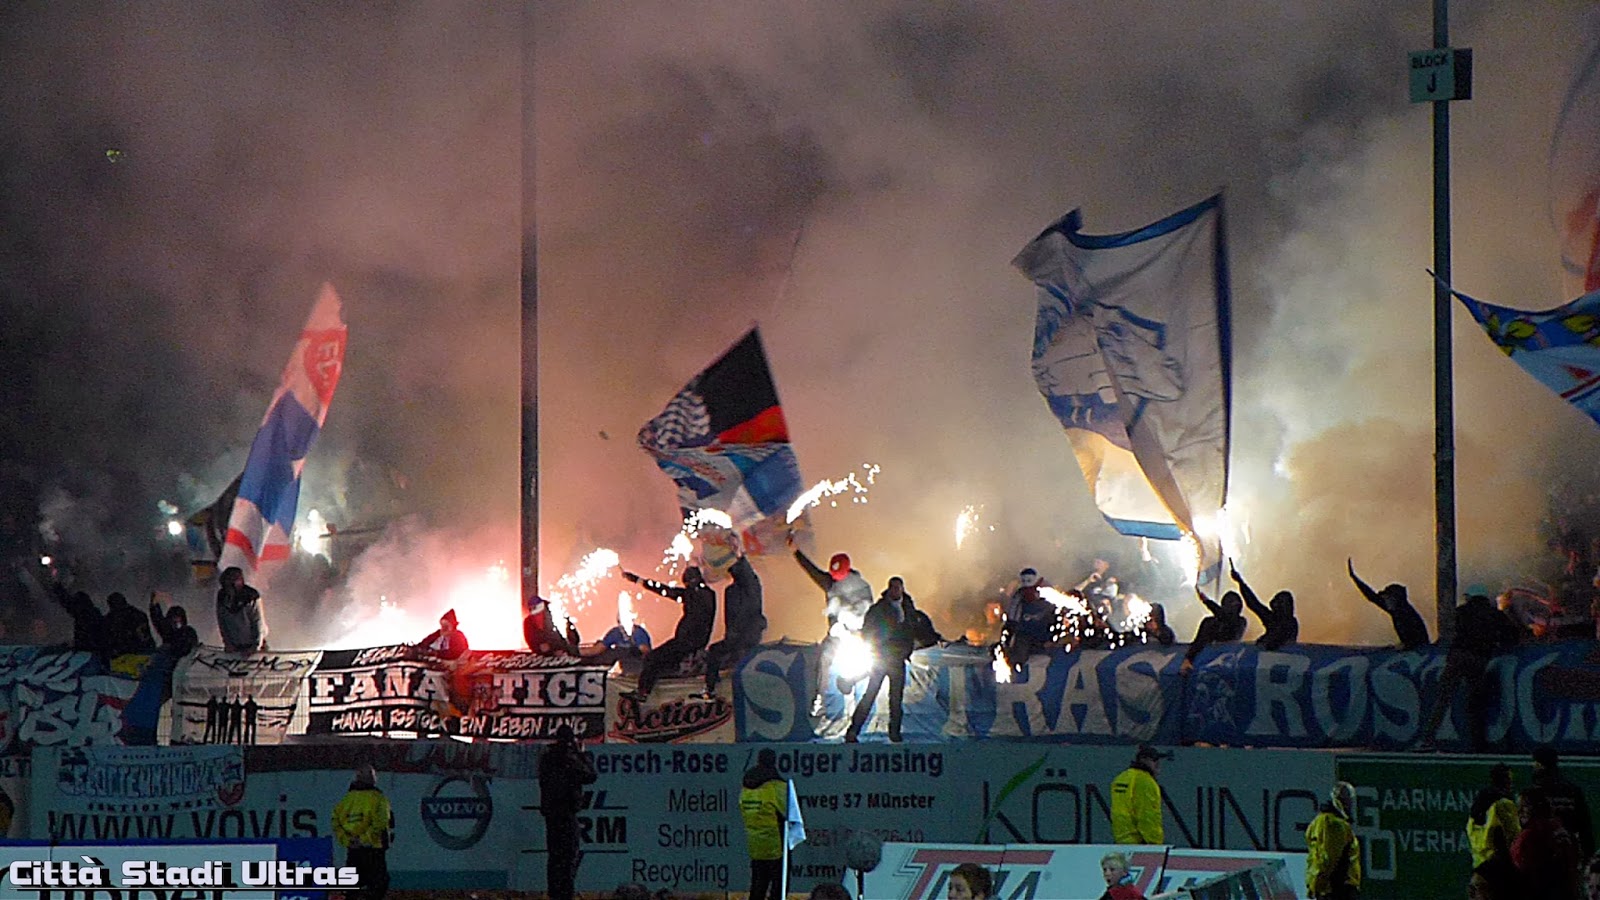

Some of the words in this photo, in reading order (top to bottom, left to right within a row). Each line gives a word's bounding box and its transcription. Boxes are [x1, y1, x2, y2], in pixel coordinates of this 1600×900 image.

[1427, 73, 1436, 93] J
[1245, 650, 1600, 744] ROSOC
[332, 709, 383, 733] HANSA
[459, 714, 486, 735] EIN
[491, 715, 542, 737] LEBEN
[616, 697, 732, 731] Action
[772, 750, 842, 777] olger
[849, 750, 943, 777] Jansing
[427, 803, 488, 819] VOLVO
[669, 789, 728, 812] Metall
[797, 796, 839, 810] rweg
[843, 792, 862, 808] 37
[868, 792, 935, 808] Münster
[578, 816, 627, 843] RM
[657, 823, 730, 847] Schrott
[632, 858, 729, 889] Recycling
